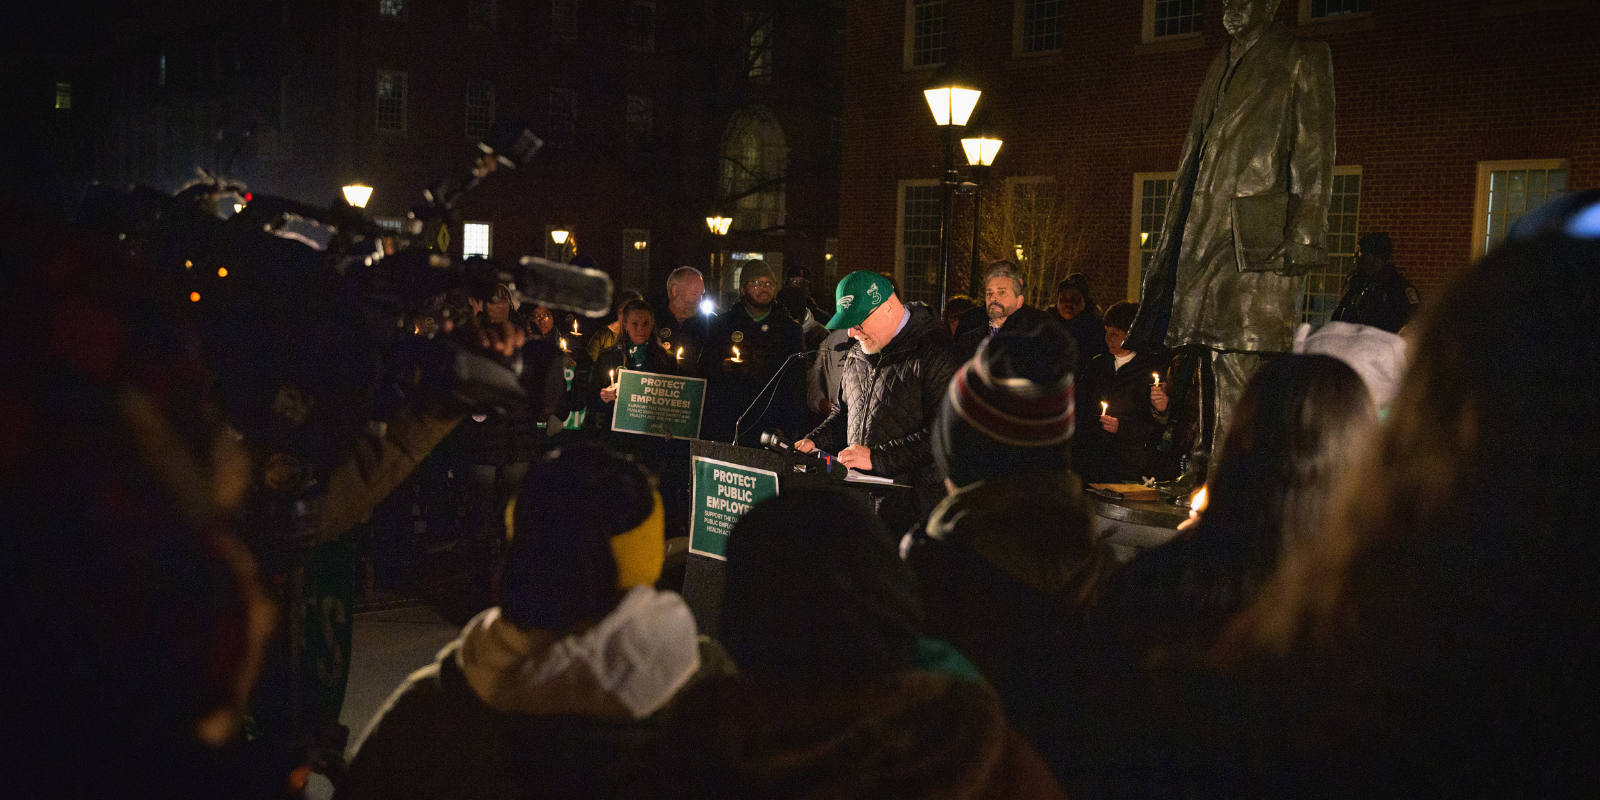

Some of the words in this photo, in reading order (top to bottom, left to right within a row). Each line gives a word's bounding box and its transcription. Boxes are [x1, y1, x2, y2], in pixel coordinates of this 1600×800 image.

[640, 377, 686, 390] PROTECT
[644, 386, 680, 399] PUBLIC
[630, 394, 691, 409] EMPLOYEES!
[713, 469, 757, 489] PROTECT
[717, 484, 753, 503] PUBLIC
[706, 495, 752, 515] EMPLOYE
[703, 517, 719, 526] PUBLIC
[704, 510, 723, 519] SUPPORT
[723, 513, 732, 521] THE
[706, 525, 722, 534] HEALTH
